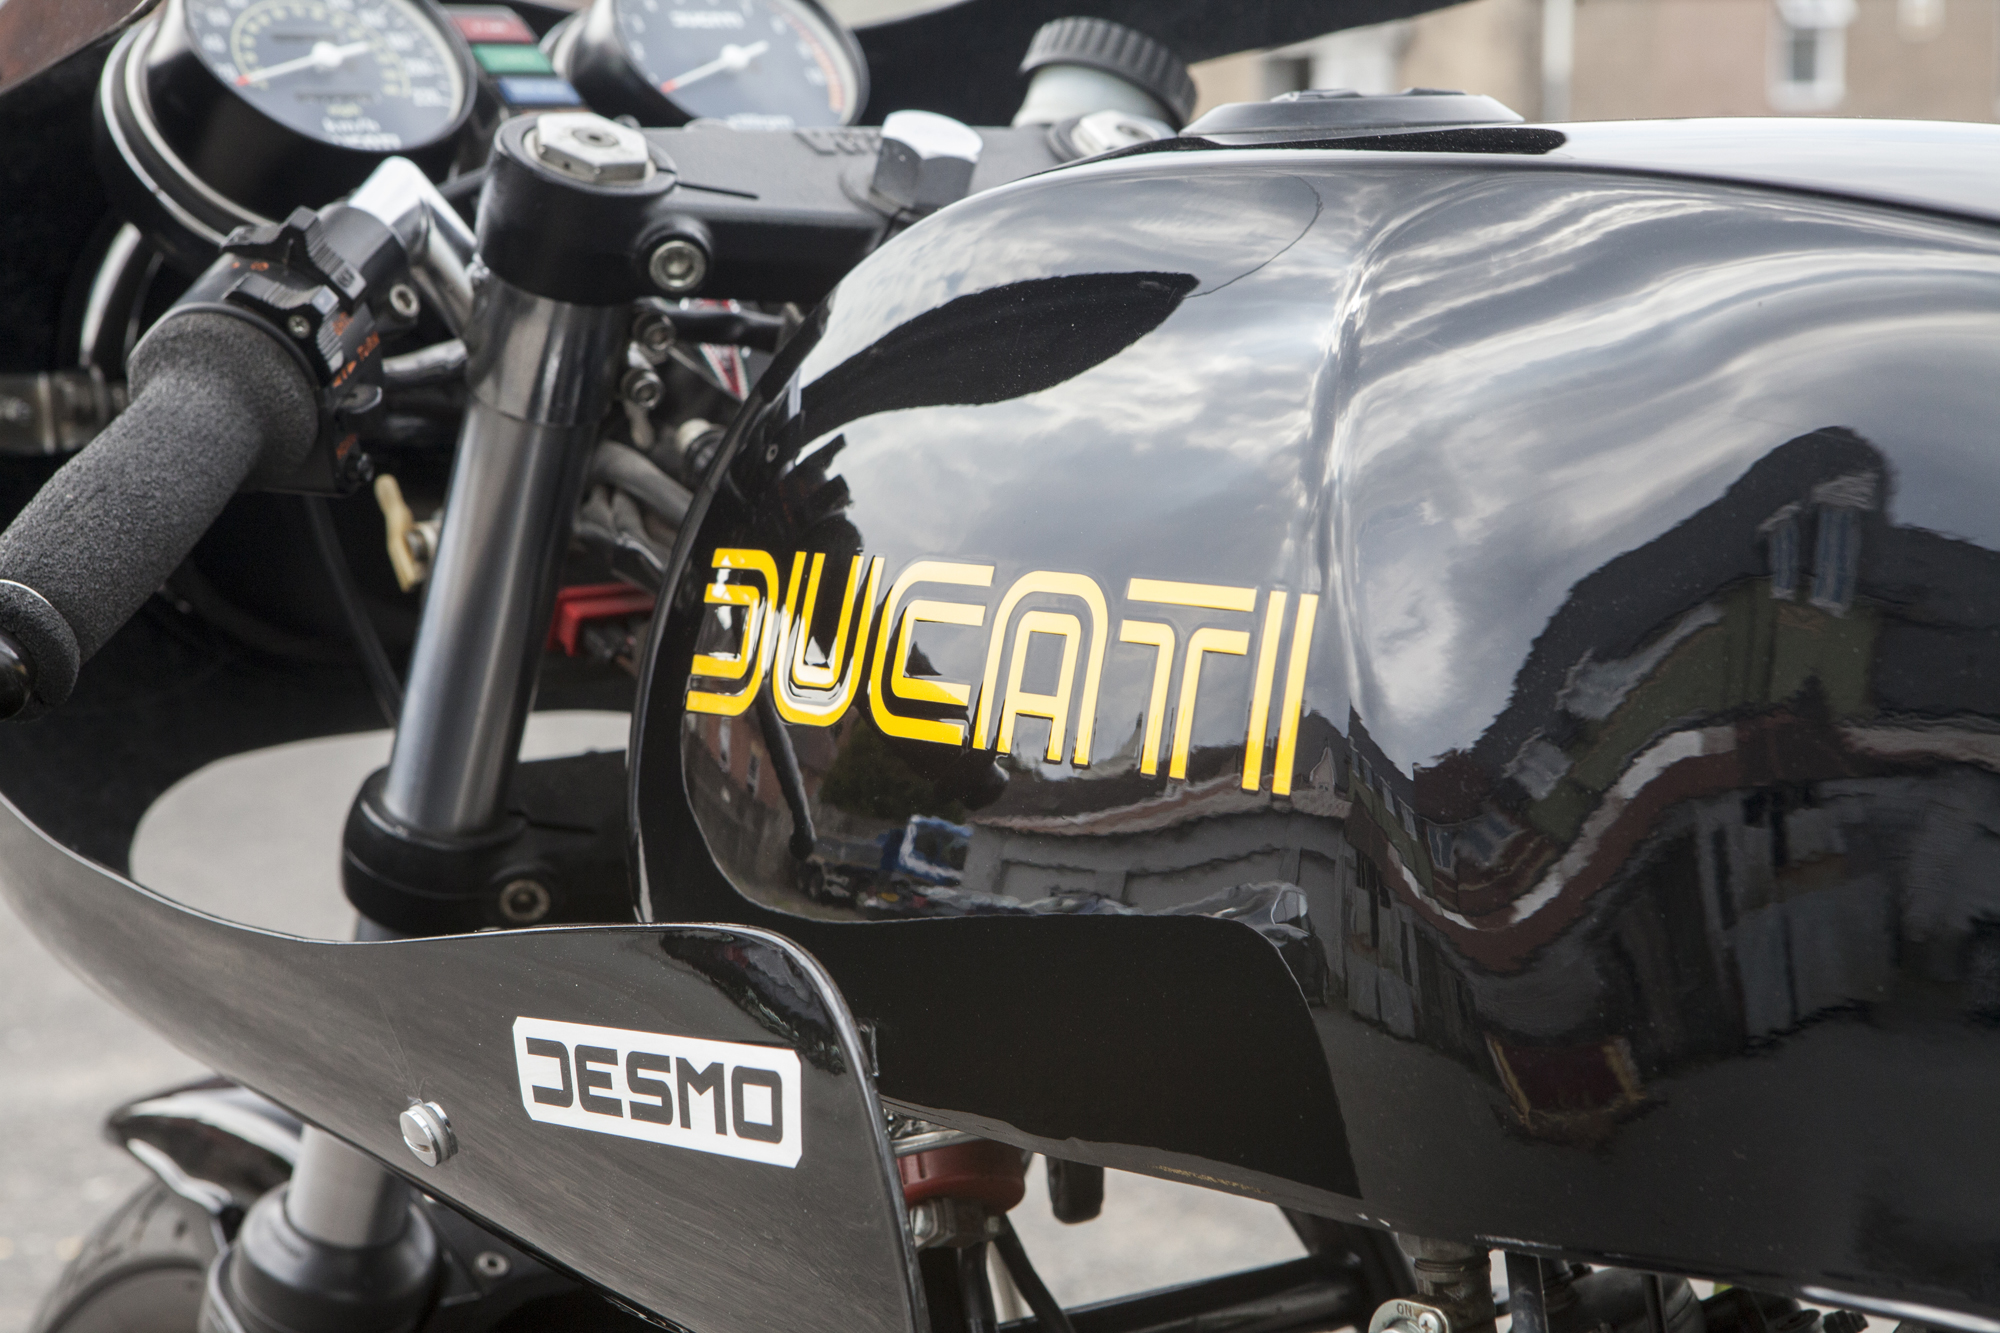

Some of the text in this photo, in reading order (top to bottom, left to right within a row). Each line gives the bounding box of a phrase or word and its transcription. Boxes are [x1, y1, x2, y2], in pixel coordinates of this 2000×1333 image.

[686, 548, 1318, 796] DUCATI
[526, 1037, 783, 1144] DESMO
[1397, 1303, 1413, 1317] ON
